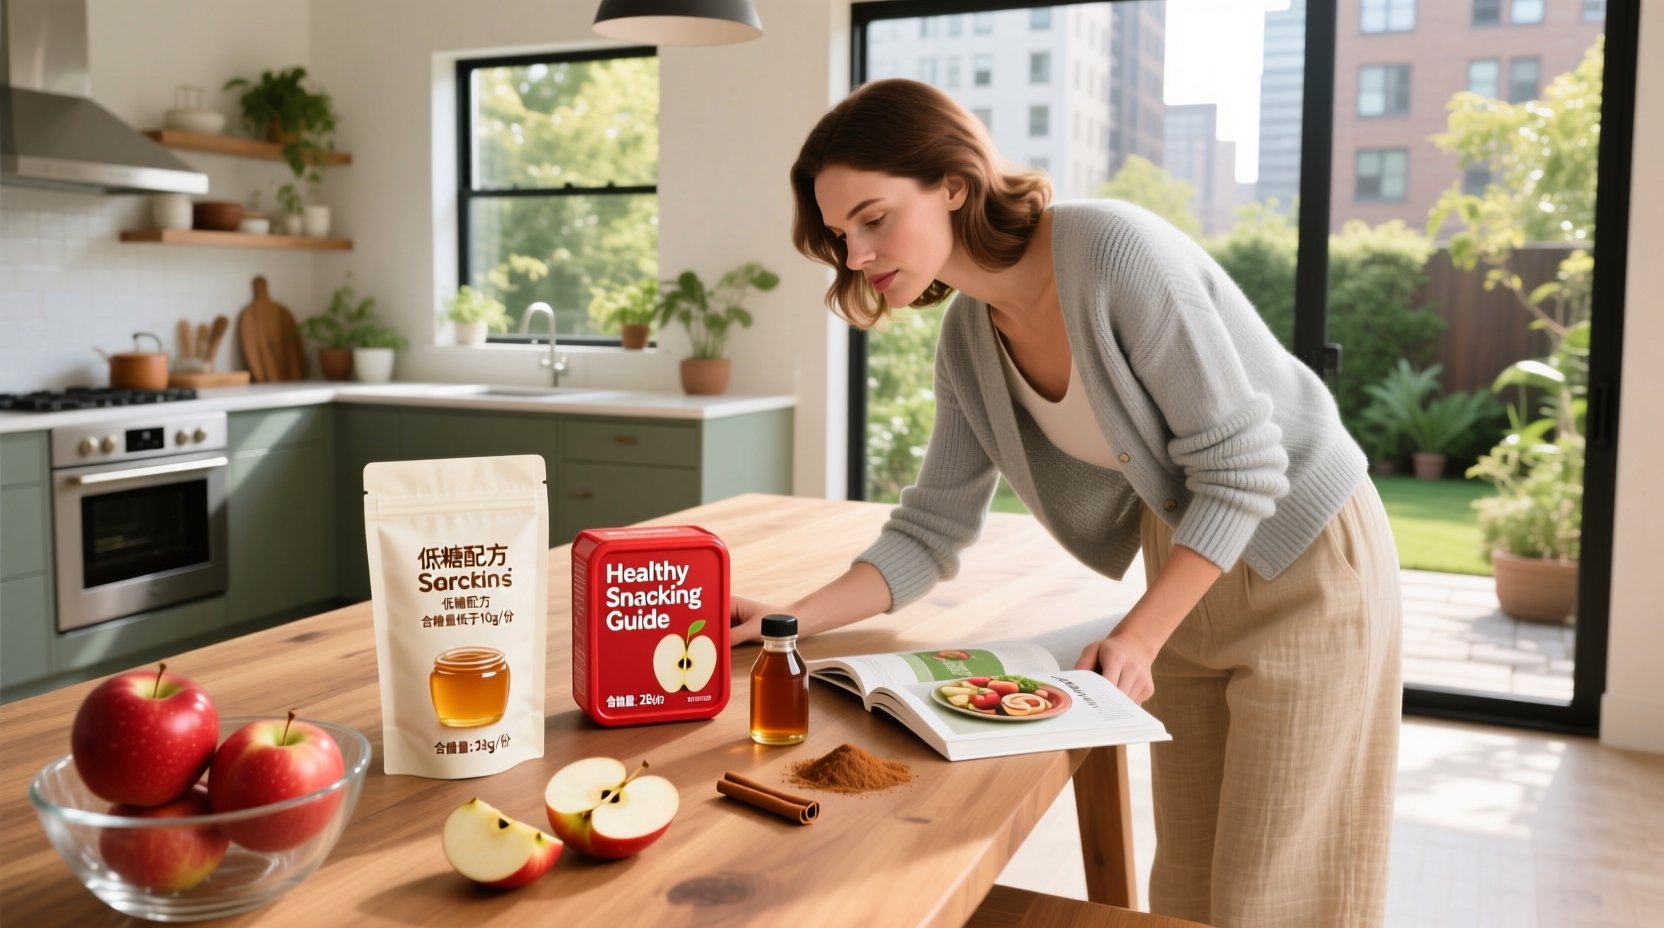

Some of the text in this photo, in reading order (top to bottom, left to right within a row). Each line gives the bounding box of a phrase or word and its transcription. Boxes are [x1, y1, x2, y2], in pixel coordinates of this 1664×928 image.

[417, 543, 508, 570] 低糖配方
[606, 560, 689, 586] Healthy
[606, 584, 702, 610] Snacking
[606, 608, 670, 631] Guide
